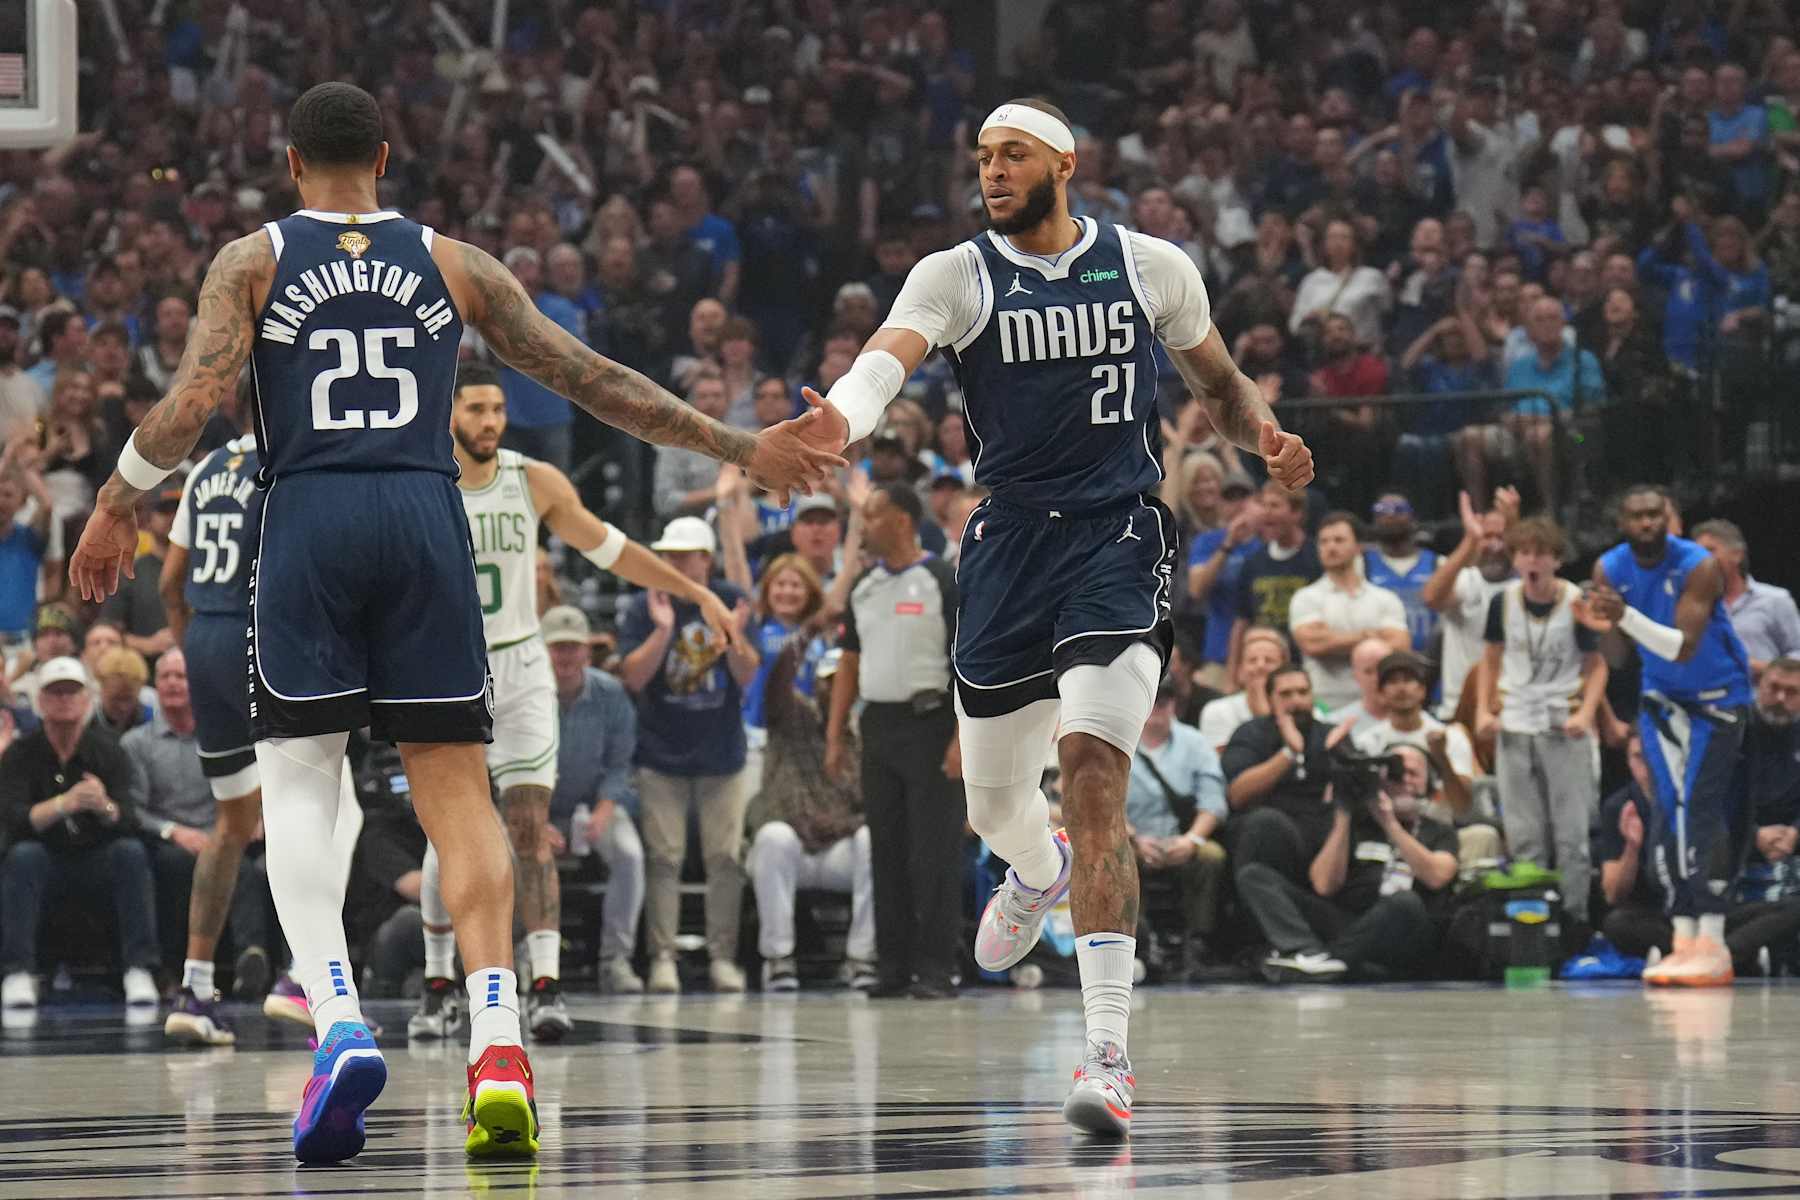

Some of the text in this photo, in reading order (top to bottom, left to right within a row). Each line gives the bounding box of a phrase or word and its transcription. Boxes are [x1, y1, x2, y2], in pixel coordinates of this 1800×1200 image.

[261, 260, 453, 345] WASHINGTON JR.
[1080, 269, 1119, 283] chime
[998, 301, 1136, 363] MAVS
[308, 327, 419, 430] 25
[1091, 362, 1136, 424] 21
[194, 471, 238, 510] JONES
[192, 513, 244, 584] 55
[474, 512, 527, 553] TICS
